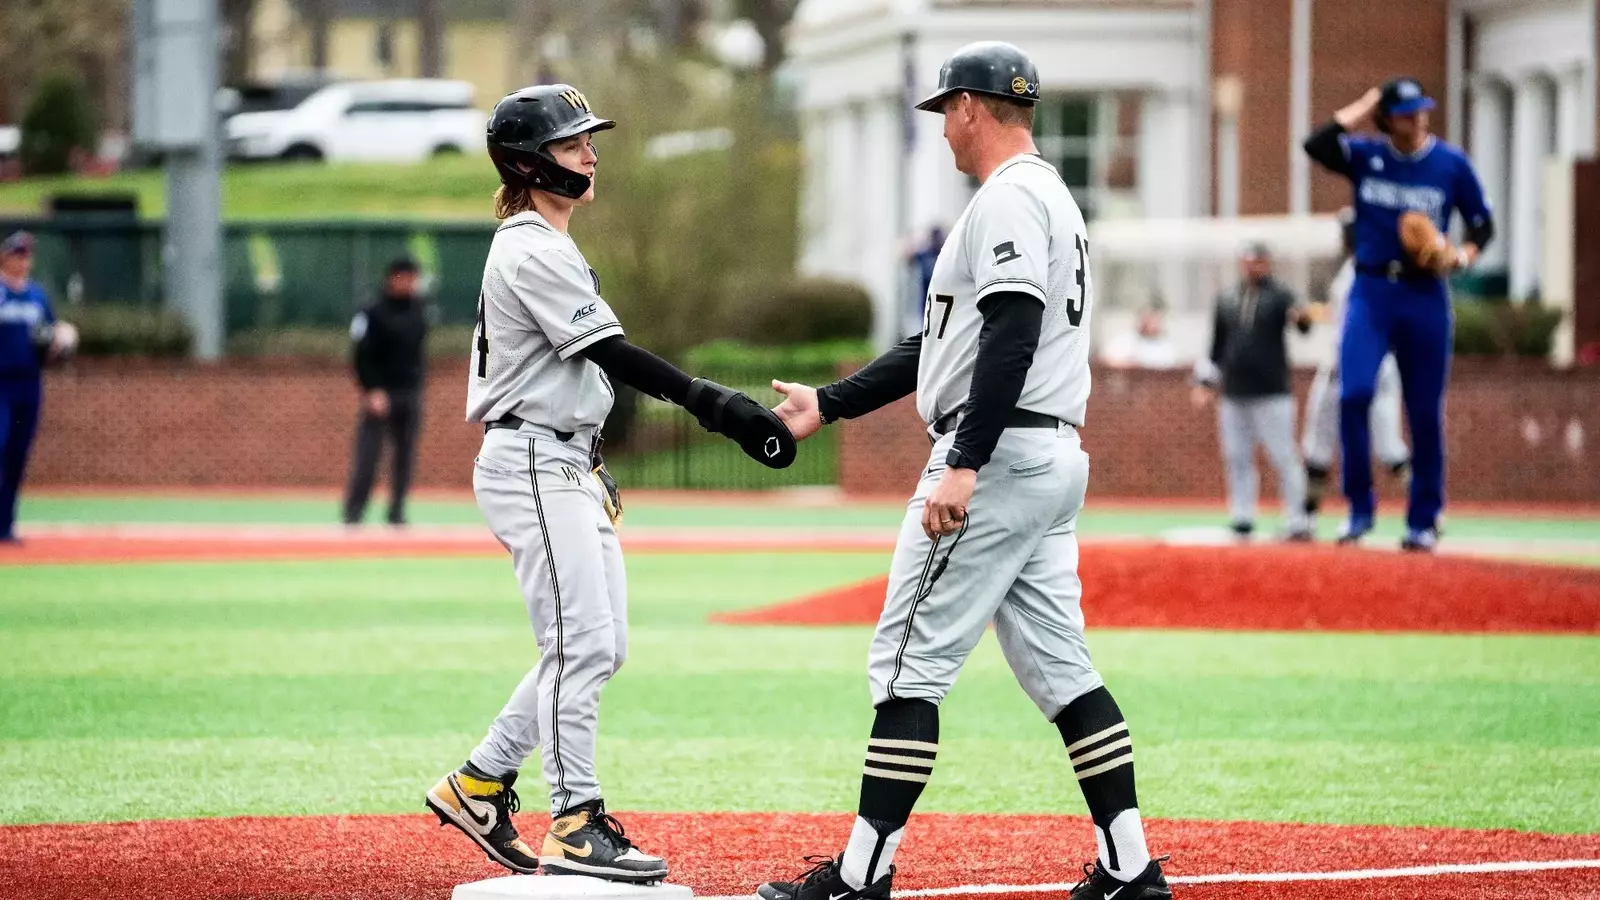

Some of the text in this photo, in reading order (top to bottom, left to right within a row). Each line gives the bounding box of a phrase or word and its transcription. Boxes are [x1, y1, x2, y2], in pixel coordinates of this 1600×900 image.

[1066, 232, 1089, 327] 3
[571, 302, 597, 321] ACC
[923, 292, 954, 340] 37
[561, 466, 583, 486] WF
